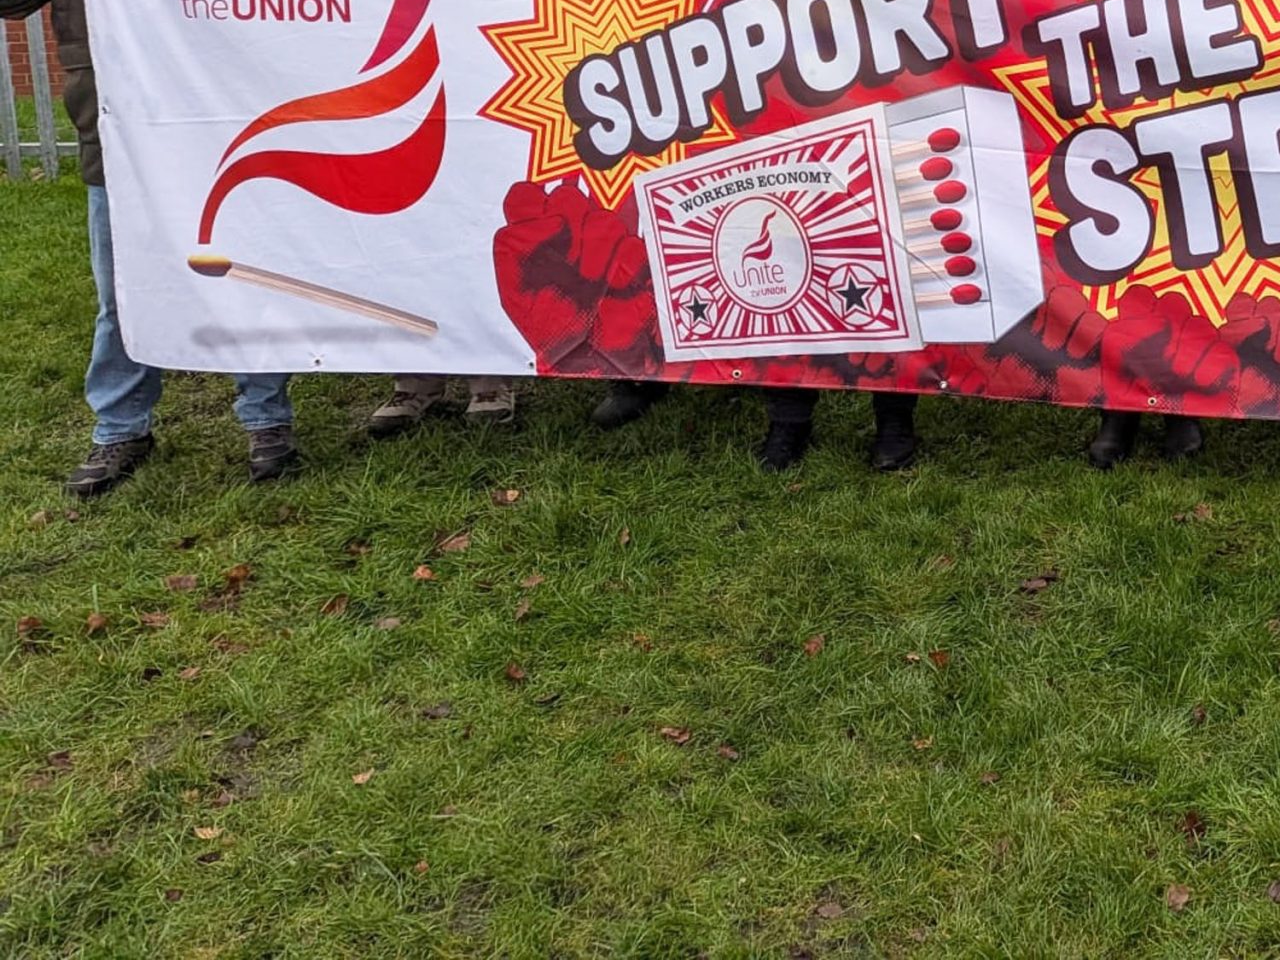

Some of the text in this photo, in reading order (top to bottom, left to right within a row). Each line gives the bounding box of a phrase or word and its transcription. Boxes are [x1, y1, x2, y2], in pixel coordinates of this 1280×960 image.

[679, 171, 832, 213] WORKERS ECONOMY
[733, 262, 784, 288] unite
